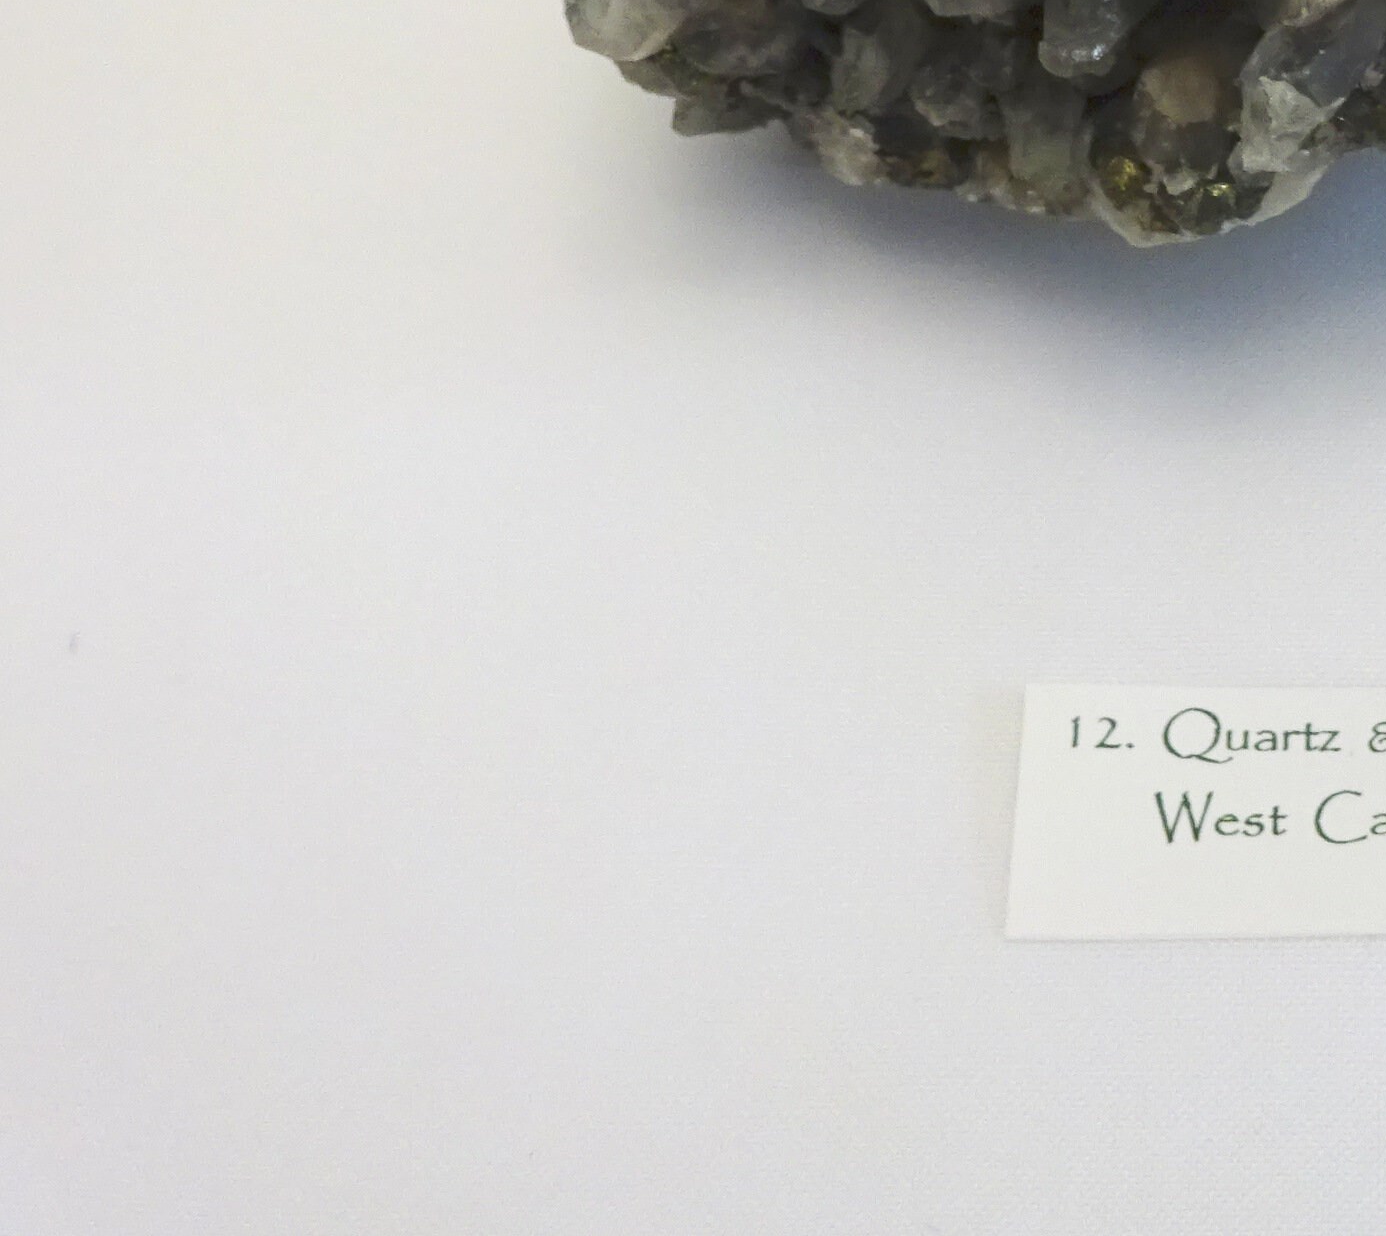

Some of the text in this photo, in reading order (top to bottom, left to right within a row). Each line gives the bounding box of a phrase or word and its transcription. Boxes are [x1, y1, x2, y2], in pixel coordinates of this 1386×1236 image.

[1069, 713, 1137, 752] 12.
[1160, 705, 1343, 766] Quartz
[1152, 789, 1290, 846] West
